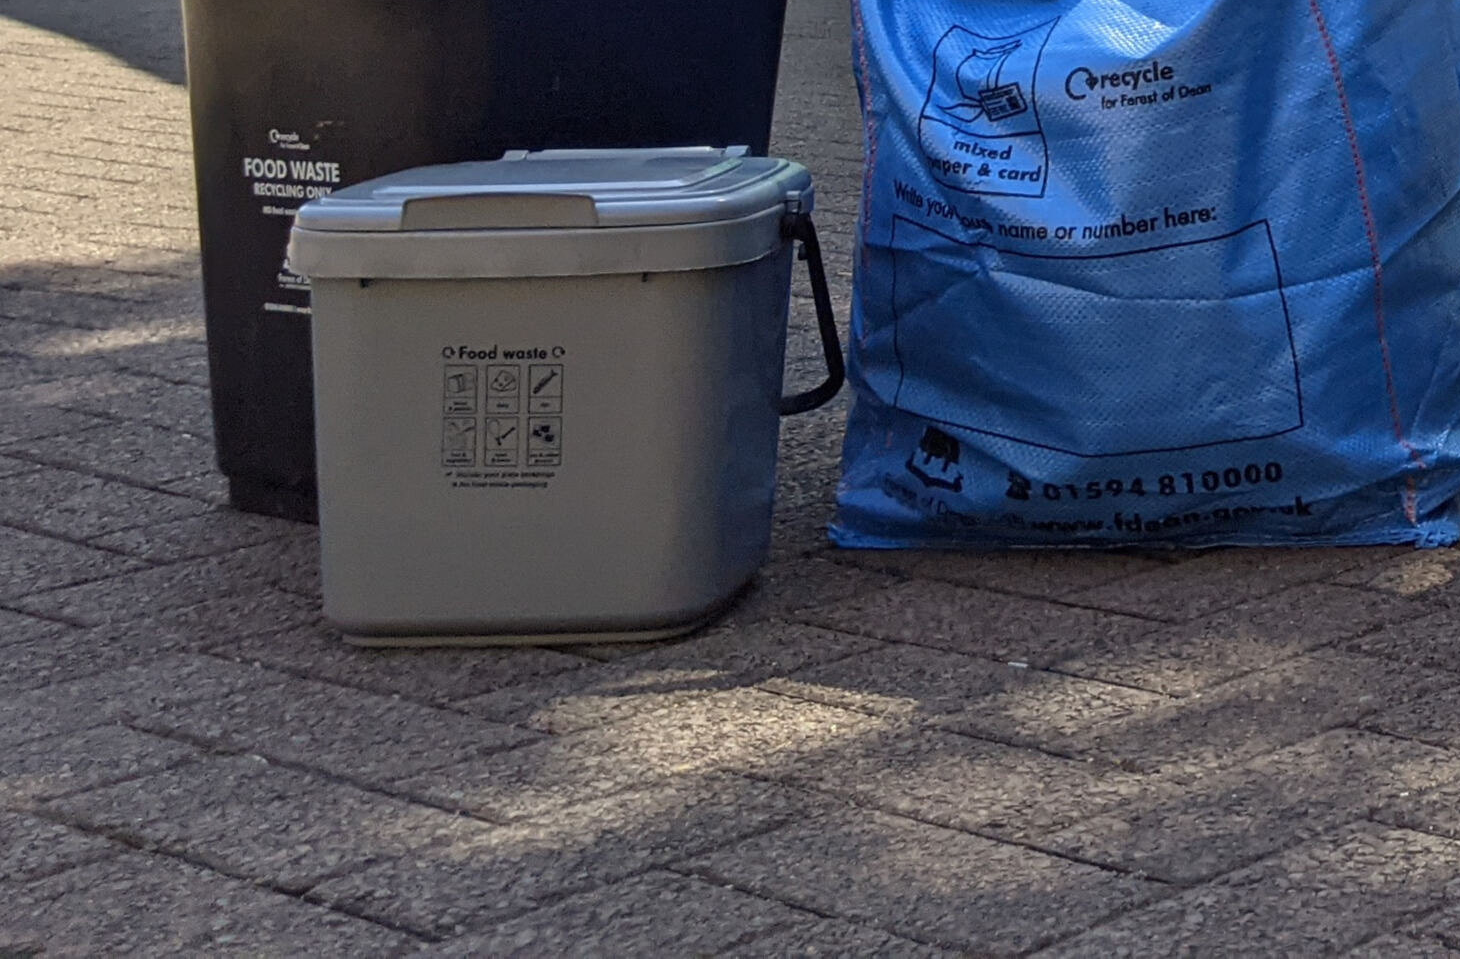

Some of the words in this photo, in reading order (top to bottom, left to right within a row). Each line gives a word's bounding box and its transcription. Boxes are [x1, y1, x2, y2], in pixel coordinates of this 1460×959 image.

[1100, 60, 1174, 91] recycle
[1101, 95, 1117, 110] for
[1161, 86, 1175, 102] of
[953, 140, 1013, 161] mixed
[243, 157, 288, 179] FOOD
[289, 159, 341, 183] WASTE
[926, 156, 973, 177] aper
[977, 163, 992, 178] &
[998, 165, 1043, 183] card
[253, 182, 304, 199] RECYCLING
[999, 223, 1048, 241] name
[1054, 224, 1078, 241] or
[1082, 213, 1157, 241] number
[1163, 204, 1217, 229] here:
[458, 343, 498, 360] Food
[502, 347, 548, 360] waste
[1043, 477, 1146, 501] 01594
[1158, 461, 1283, 497] 810000
